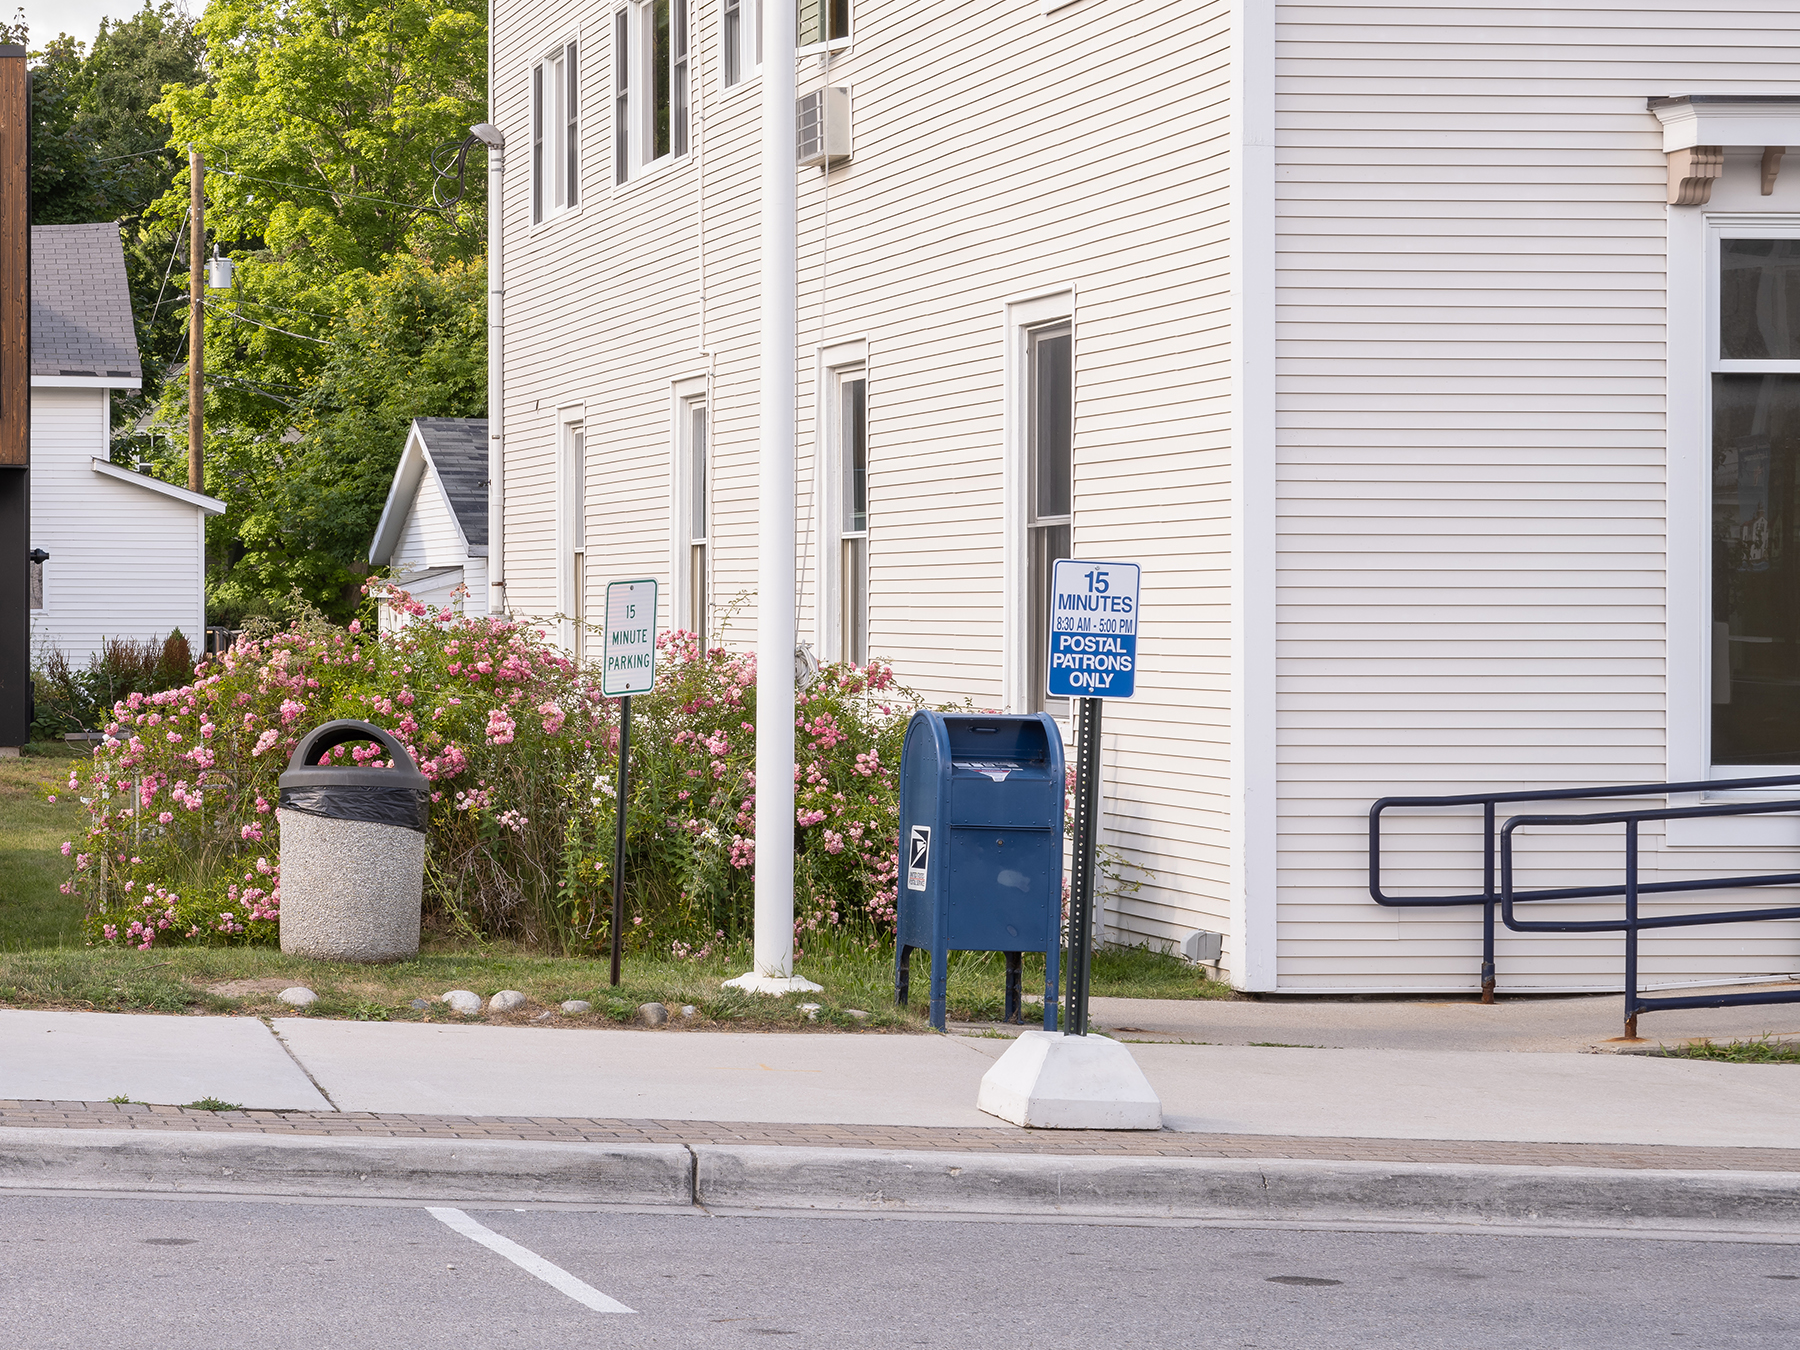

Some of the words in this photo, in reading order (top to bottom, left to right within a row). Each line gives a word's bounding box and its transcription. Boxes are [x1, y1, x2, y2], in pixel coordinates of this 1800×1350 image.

[1084, 570, 1110, 594] 15
[626, 604, 636, 619] 15
[1058, 593, 1133, 613] MINUTES
[1056, 616, 1074, 631] 8:30
[1076, 617, 1091, 632] AM
[1098, 618, 1117, 633] 5:00
[1119, 619, 1133, 633] PM
[612, 629, 648, 646] MINUTE
[1059, 635, 1127, 653] POSTAL
[608, 653, 650, 671] PARKING
[1053, 653, 1132, 672] PATRONS
[1069, 671, 1115, 688] ONLY
